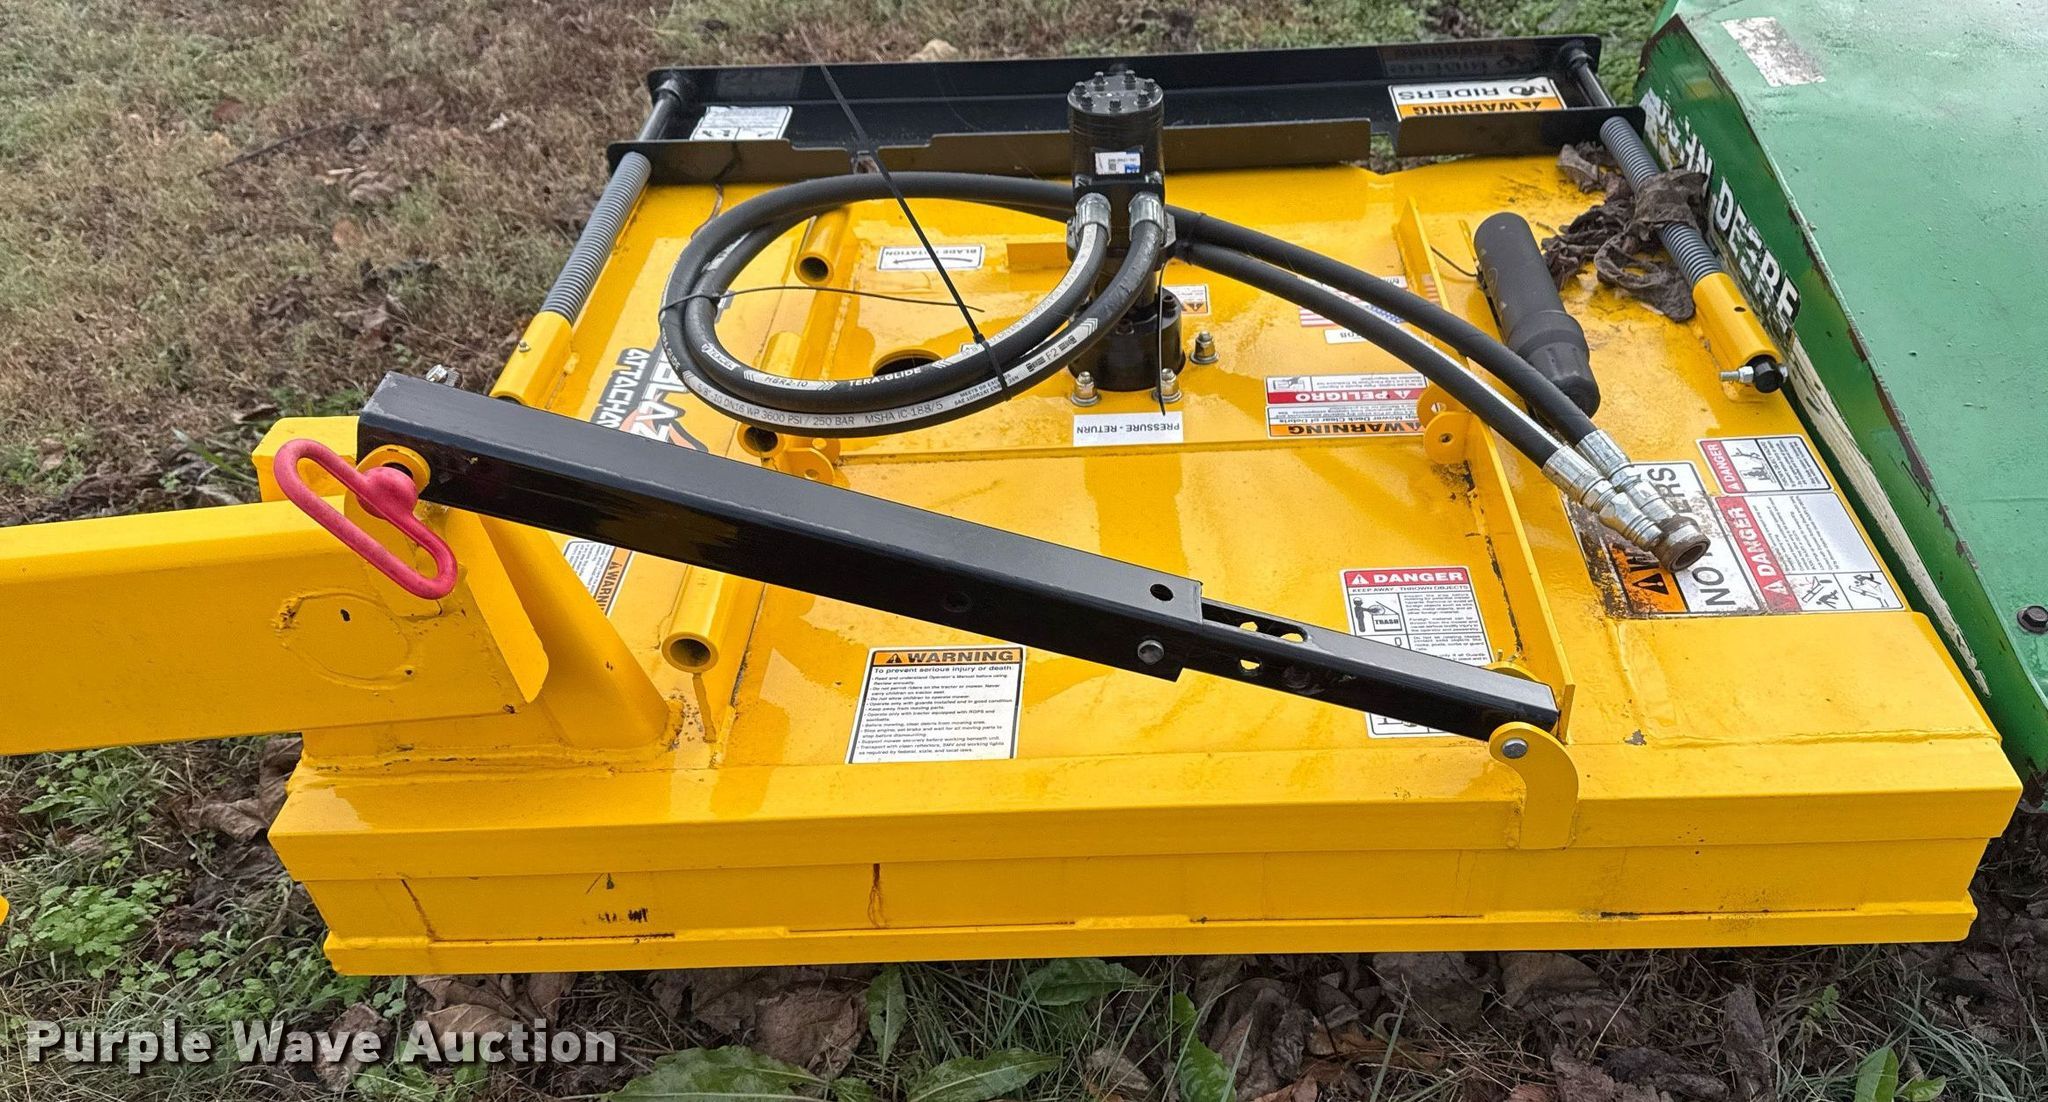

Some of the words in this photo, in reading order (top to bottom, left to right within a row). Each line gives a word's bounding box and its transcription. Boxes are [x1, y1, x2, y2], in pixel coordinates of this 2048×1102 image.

[1398, 87, 1498, 100] RIDERS
[1413, 101, 1518, 115] WARNING
[849, 367, 922, 387] TERA-GLIDE
[596, 349, 650, 429] ATTACHM
[1295, 390, 1389, 402] PELIGRO
[761, 408, 785, 423] 3600
[787, 411, 801, 424] PSI
[813, 413, 832, 425] 250
[835, 413, 855, 426] BAR
[865, 411, 896, 424] MSHA
[1076, 425, 1117, 434] RETURN
[1125, 423, 1180, 433] PRESSURE
[1288, 422, 1405, 435] WARNING
[1707, 444, 1738, 484] DANGER
[1729, 506, 1776, 577] DANGER
[1373, 571, 1464, 583] DANGER
[1692, 566, 1736, 606] NO
[1374, 618, 1399, 626] TRASH
[907, 650, 1013, 663] WARNING
